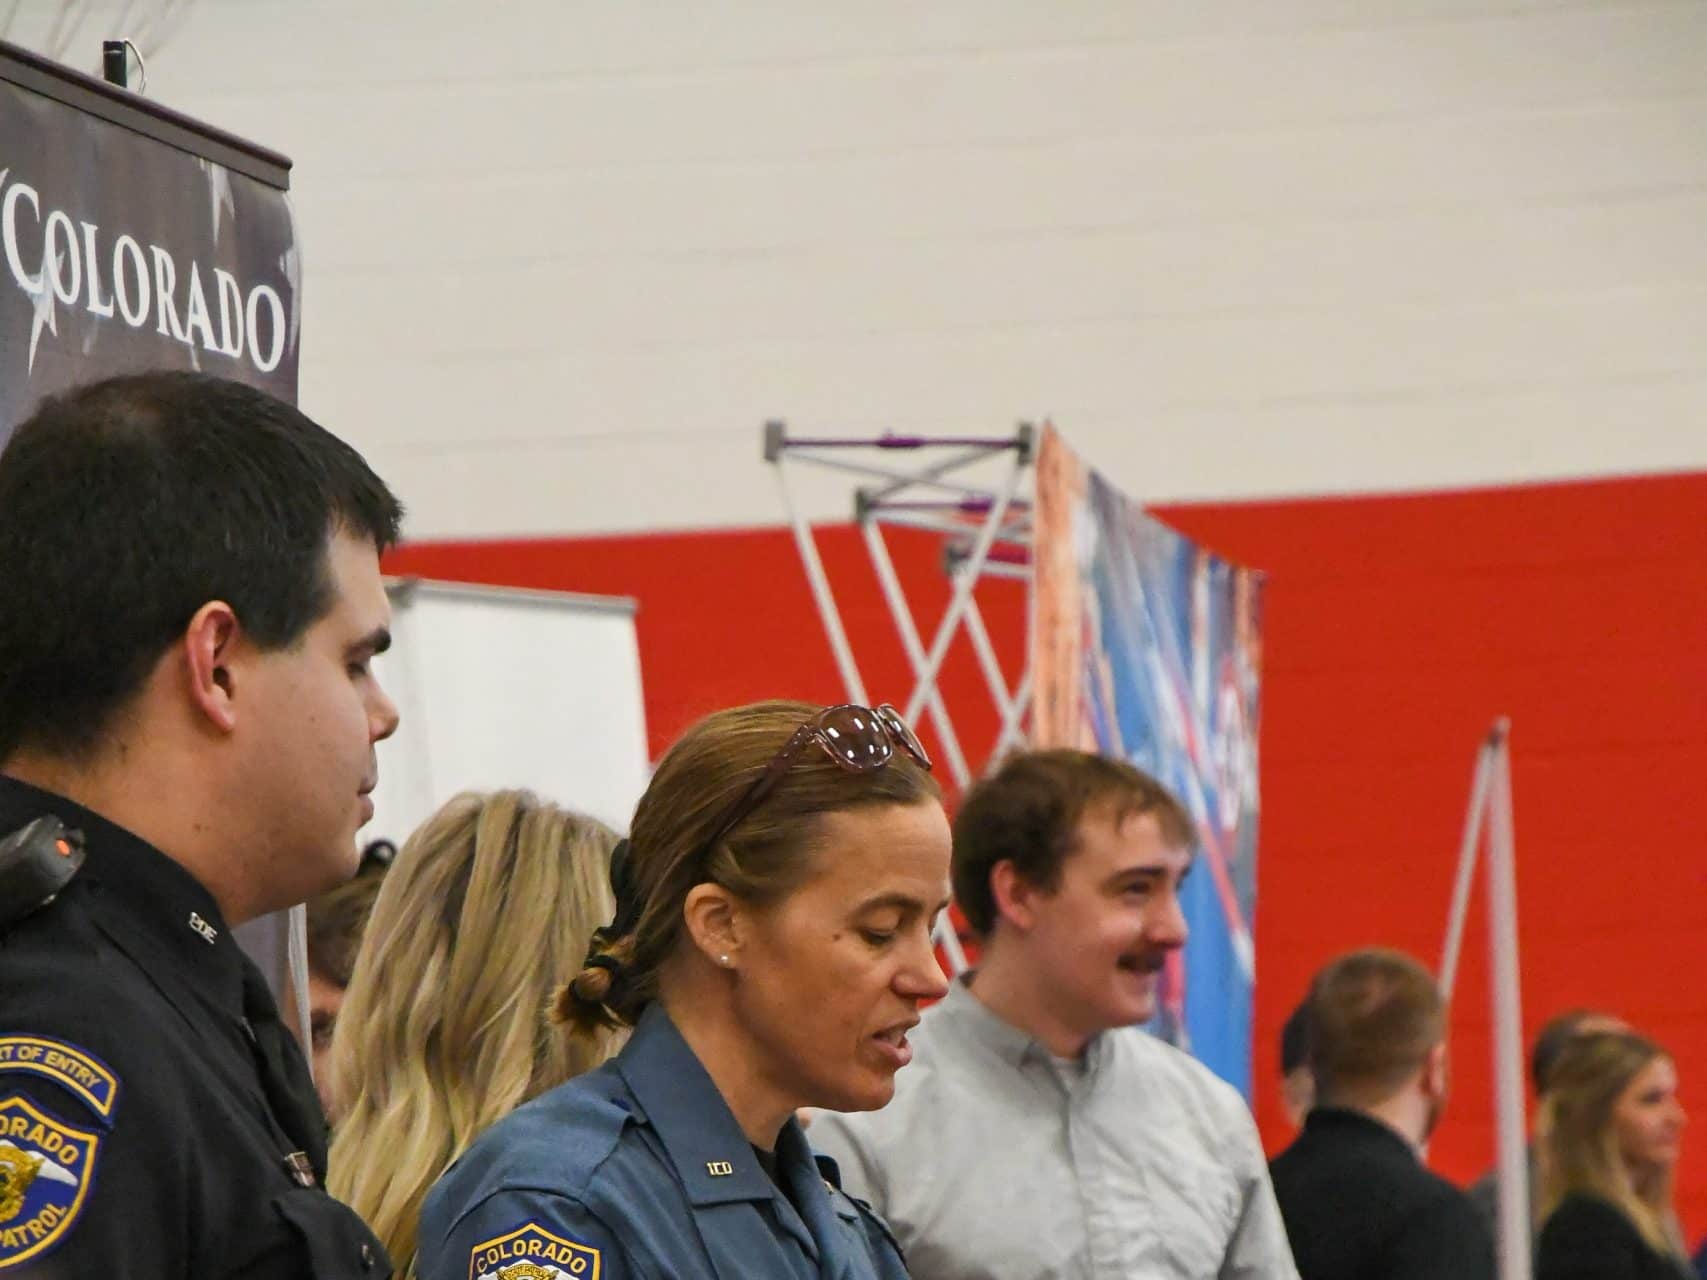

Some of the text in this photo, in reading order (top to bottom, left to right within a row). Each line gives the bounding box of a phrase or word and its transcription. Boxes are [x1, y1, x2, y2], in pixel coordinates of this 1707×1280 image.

[2, 183, 286, 373] COLORADO
[18, 1045, 43, 1061] OF
[45, 1050, 101, 1088] ENTRY
[0, 1116, 80, 1166] ORADO
[0, 1202, 68, 1249] ATROL
[476, 1238, 588, 1274] COLORADO
